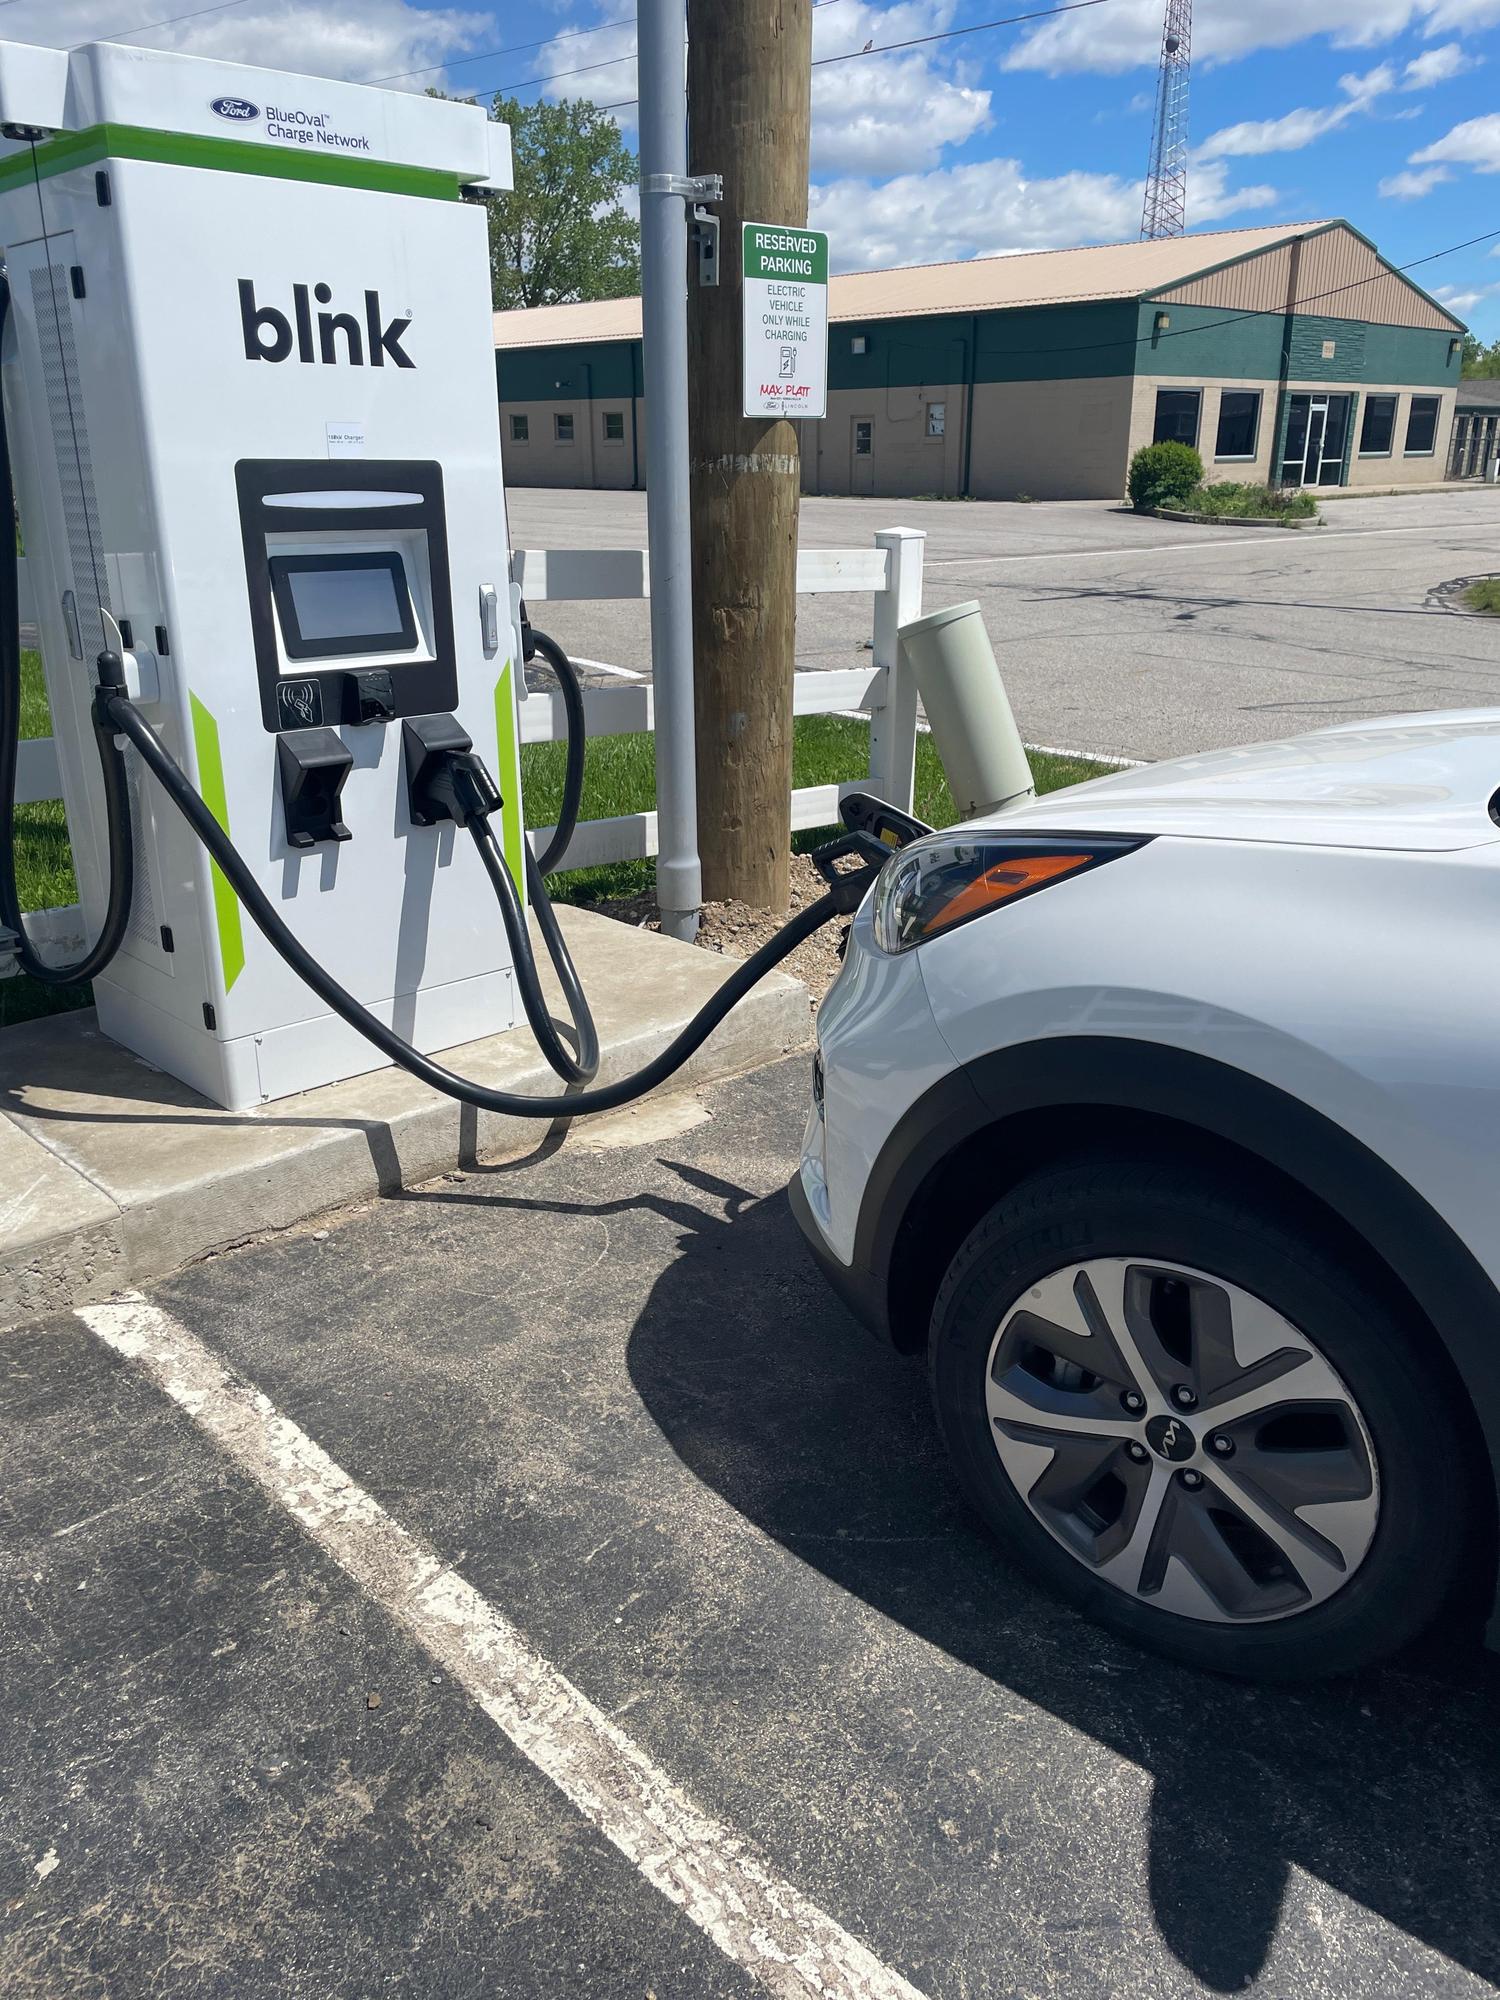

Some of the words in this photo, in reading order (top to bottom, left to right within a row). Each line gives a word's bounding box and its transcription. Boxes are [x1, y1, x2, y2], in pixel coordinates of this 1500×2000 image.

[219, 100, 251, 118] Ford
[267, 123, 314, 143] Charge
[317, 129, 370, 150] Network
[755, 233, 817, 254] RESERVED
[760, 255, 812, 275] PARKING
[767, 284, 806, 298] ELECTRIC
[769, 300, 804, 312] VEHICLE
[762, 314, 784, 326] ONLY
[785, 316, 810, 328] WHILE
[765, 329, 808, 342] CHARGING
[760, 384, 783, 396] MAX
[786, 385, 811, 397] PLATT
